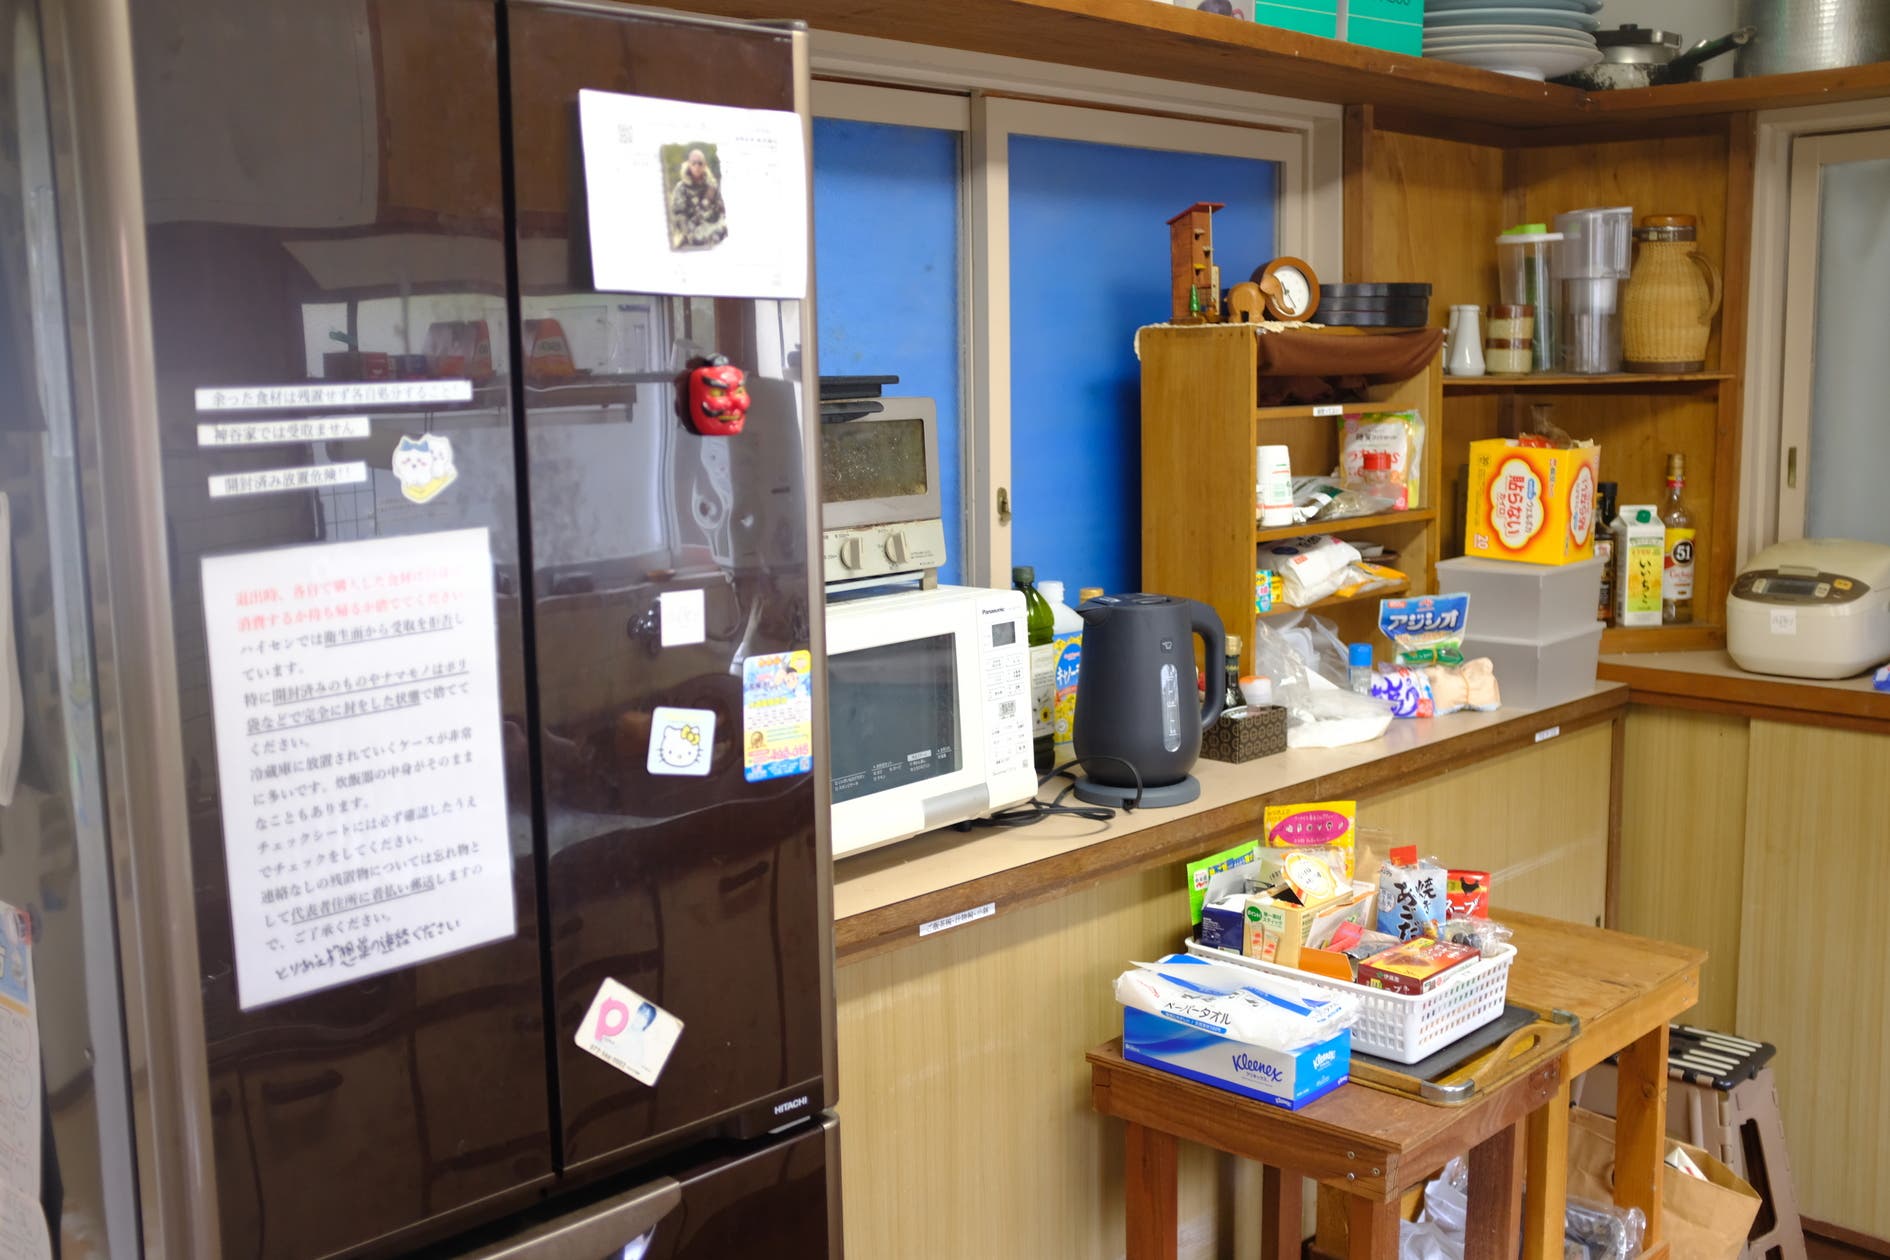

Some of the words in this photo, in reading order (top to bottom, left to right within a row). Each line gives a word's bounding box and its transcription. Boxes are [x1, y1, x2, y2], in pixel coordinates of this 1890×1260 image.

[1508, 476, 1524, 535] 貼らない
[1677, 545, 1692, 561] 51
[1639, 560, 1652, 605] いいちこ
[1388, 609, 1459, 631] アジシオ
[243, 661, 304, 681] ています。
[250, 738, 310, 757] ください。
[255, 796, 369, 831] なこともあります。
[1415, 877, 1437, 914] 焼き
[1165, 1000, 1231, 1025] ペーパータオル
[1232, 1053, 1283, 1082] Kleenex
[1312, 1050, 1336, 1070] Kleenex
[774, 1095, 808, 1115] HITACHI
